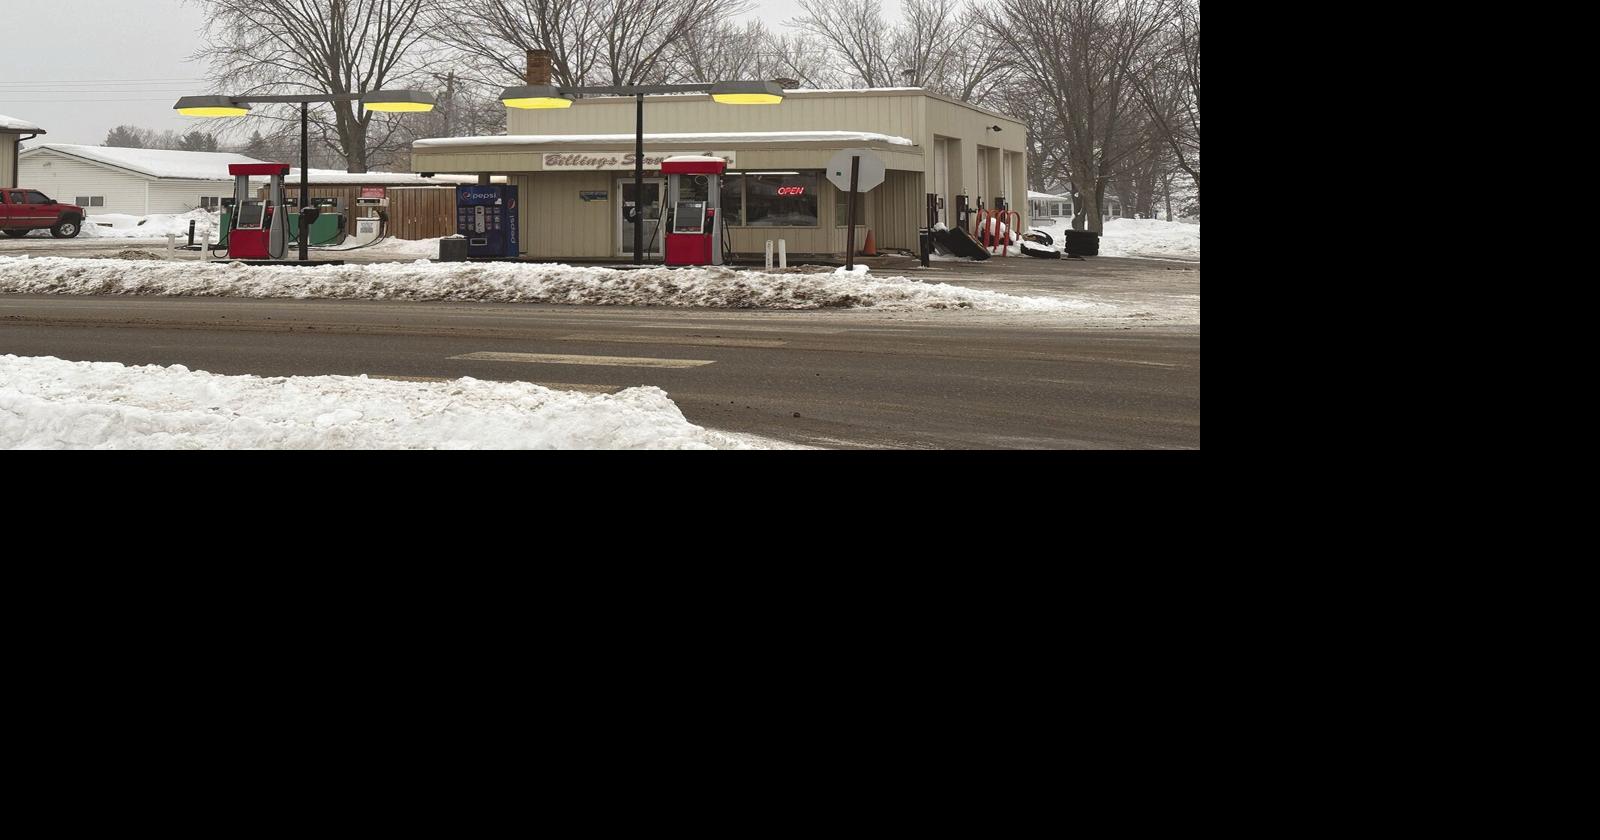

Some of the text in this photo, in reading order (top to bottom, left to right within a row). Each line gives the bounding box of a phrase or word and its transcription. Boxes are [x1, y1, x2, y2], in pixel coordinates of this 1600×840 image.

[544, 154, 617, 168] Billings
[778, 186, 804, 195] OPEN
[472, 192, 497, 200] pepsi
